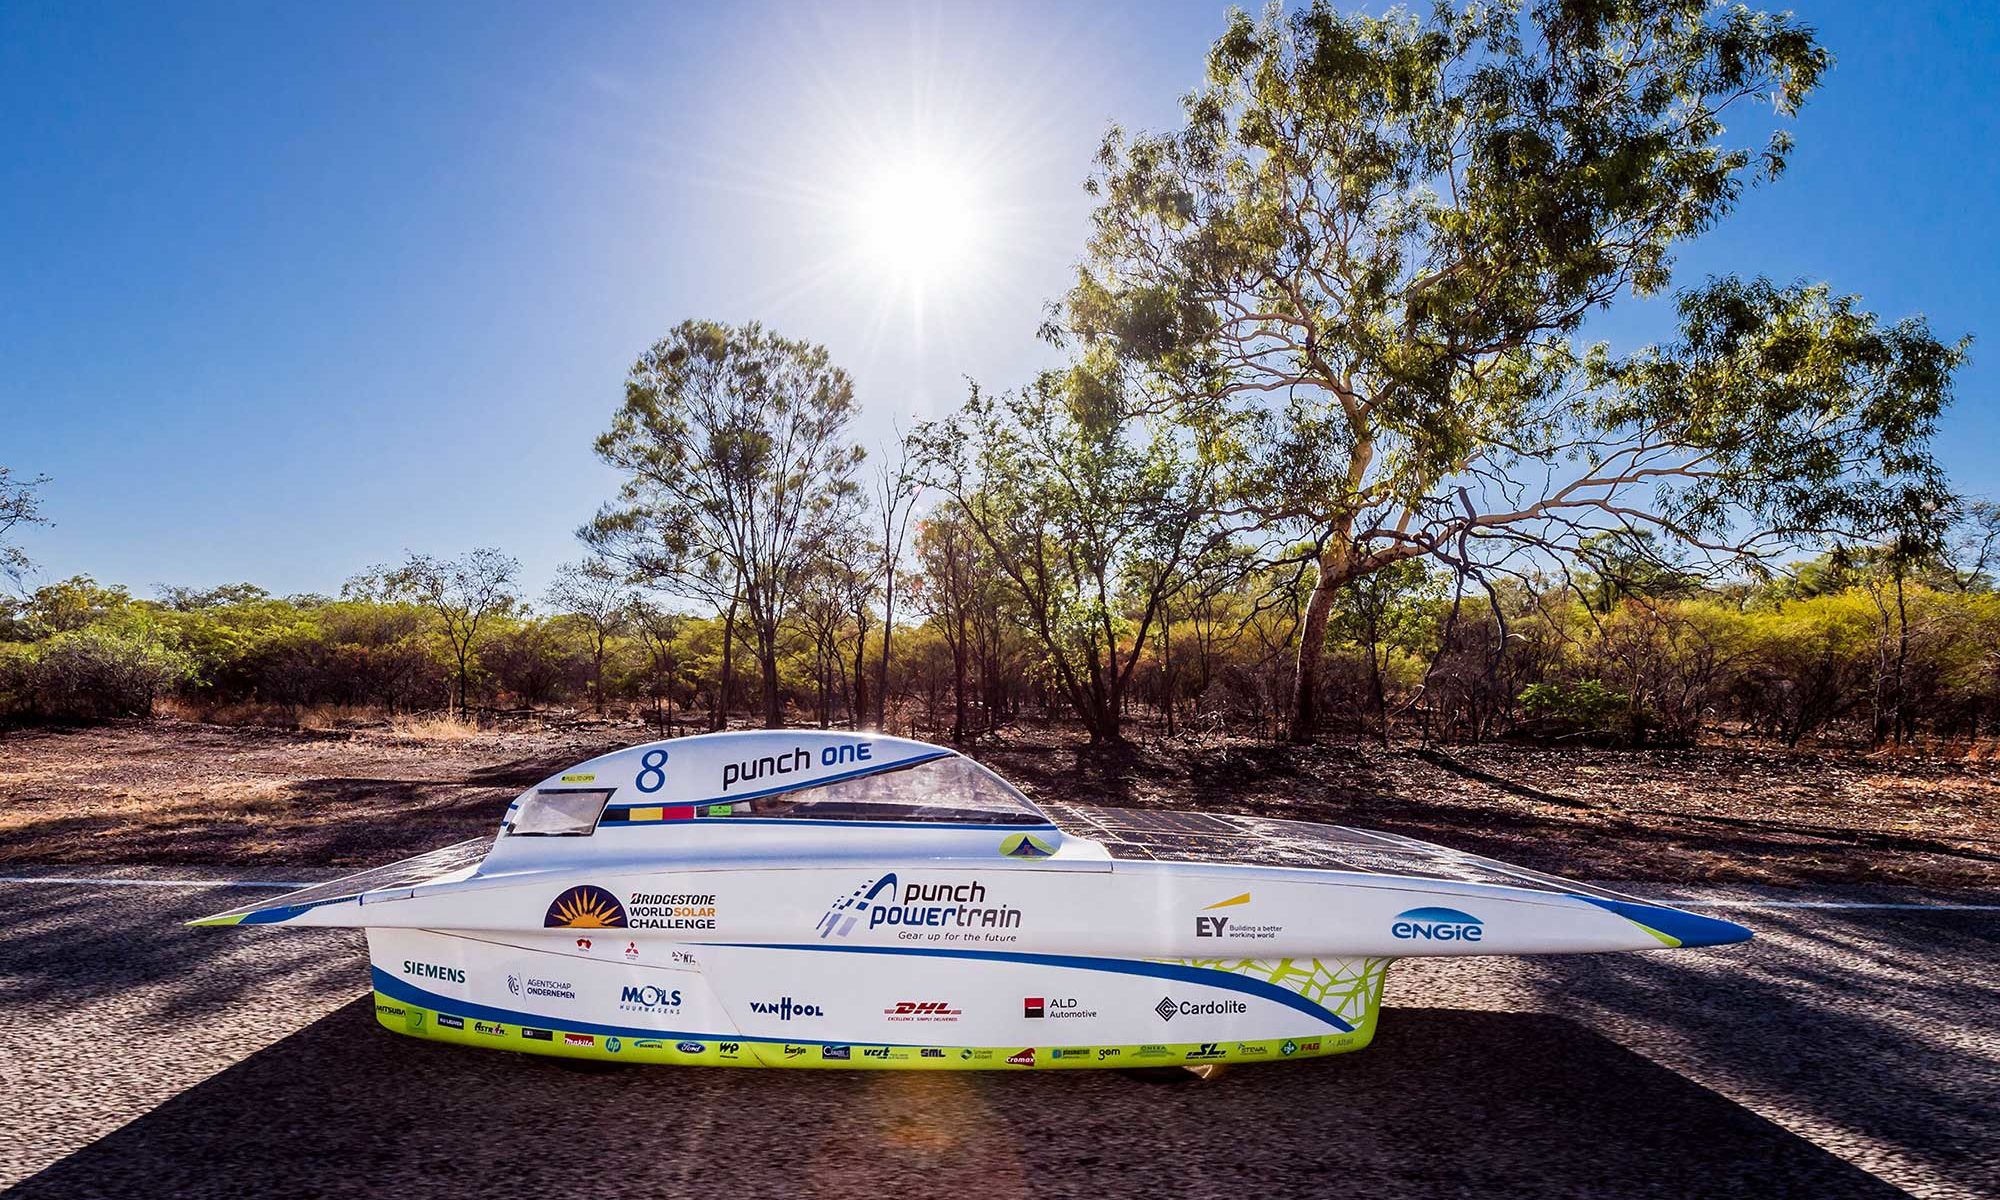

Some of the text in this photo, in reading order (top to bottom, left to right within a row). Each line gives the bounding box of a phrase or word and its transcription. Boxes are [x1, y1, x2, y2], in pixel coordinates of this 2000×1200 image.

[635, 749, 669, 793] 8
[723, 747, 811, 791] punch
[630, 893, 716, 905] BRIDGESTONE
[904, 881, 986, 905] punch
[869, 905, 1022, 930] powertrain
[629, 919, 716, 929] CHALLENGE
[1196, 917, 1229, 937] EY
[898, 931, 1017, 942] Gear up for the future
[403, 960, 466, 983] SIEMENS
[527, 978, 572, 989] AGENTSCHAP
[527, 988, 576, 999] ONDERNEMEN
[621, 985, 681, 1006] MOLS
[894, 1002, 951, 1015] DHL
[1050, 999, 1078, 1008] ALD
[1180, 1001, 1247, 1015] Cardolite
[620, 1005, 681, 1015] HUURWAGENS
[1050, 1010, 1097, 1018] Automotive
[565, 1038, 594, 1047] makita
[607, 1038, 621, 1053] hp
[681, 1043, 702, 1053] Ford
[1300, 1042, 1320, 1051] FAG
